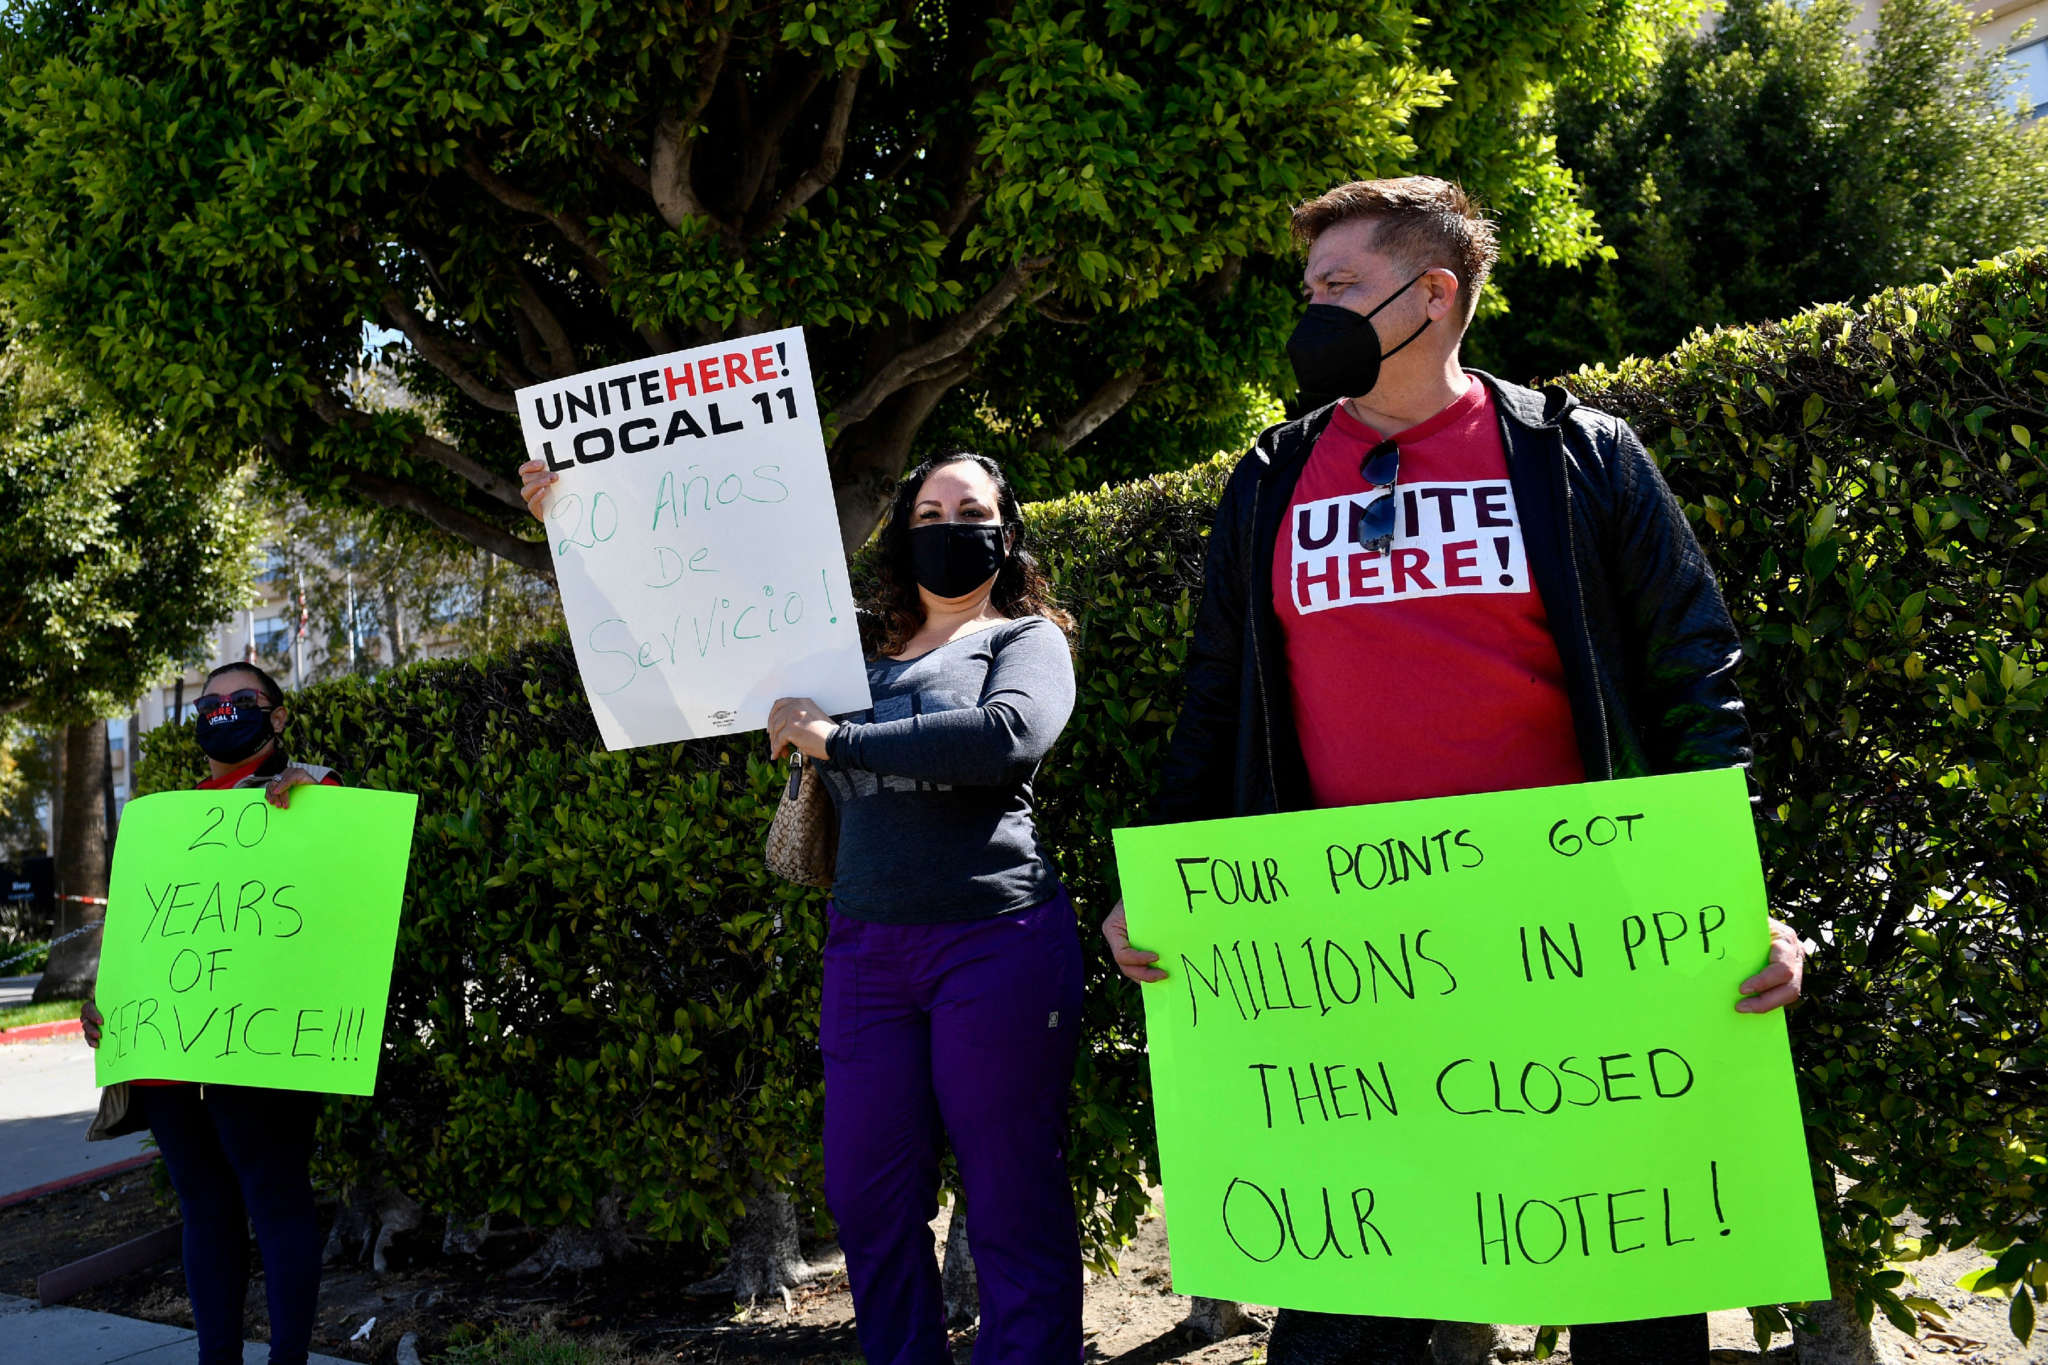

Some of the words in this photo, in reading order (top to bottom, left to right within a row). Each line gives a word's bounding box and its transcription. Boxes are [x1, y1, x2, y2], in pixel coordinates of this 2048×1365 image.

[542, 402, 744, 472] LOCAL
[752, 387, 798, 424] 11
[550, 491, 618, 556] 20
[653, 464, 789, 532] Años
[1297, 536, 1515, 608] HERE!
[188, 801, 268, 851] 20
[1176, 856, 1290, 914] FOUR
[1325, 829, 1485, 894] POINTS
[1549, 813, 1645, 857] GOT
[141, 879, 303, 943] YEARS
[168, 948, 233, 993] OF
[1180, 928, 1458, 1028] MILLIONS
[1518, 922, 1583, 983] IN
[105, 997, 365, 1068] SERVICE!!!
[1249, 1061, 1399, 1129] THEN
[1436, 1047, 1695, 1115] CLOSED
[1222, 1176, 1393, 1263] OUR
[1475, 1160, 1731, 1266] HOTEL!
